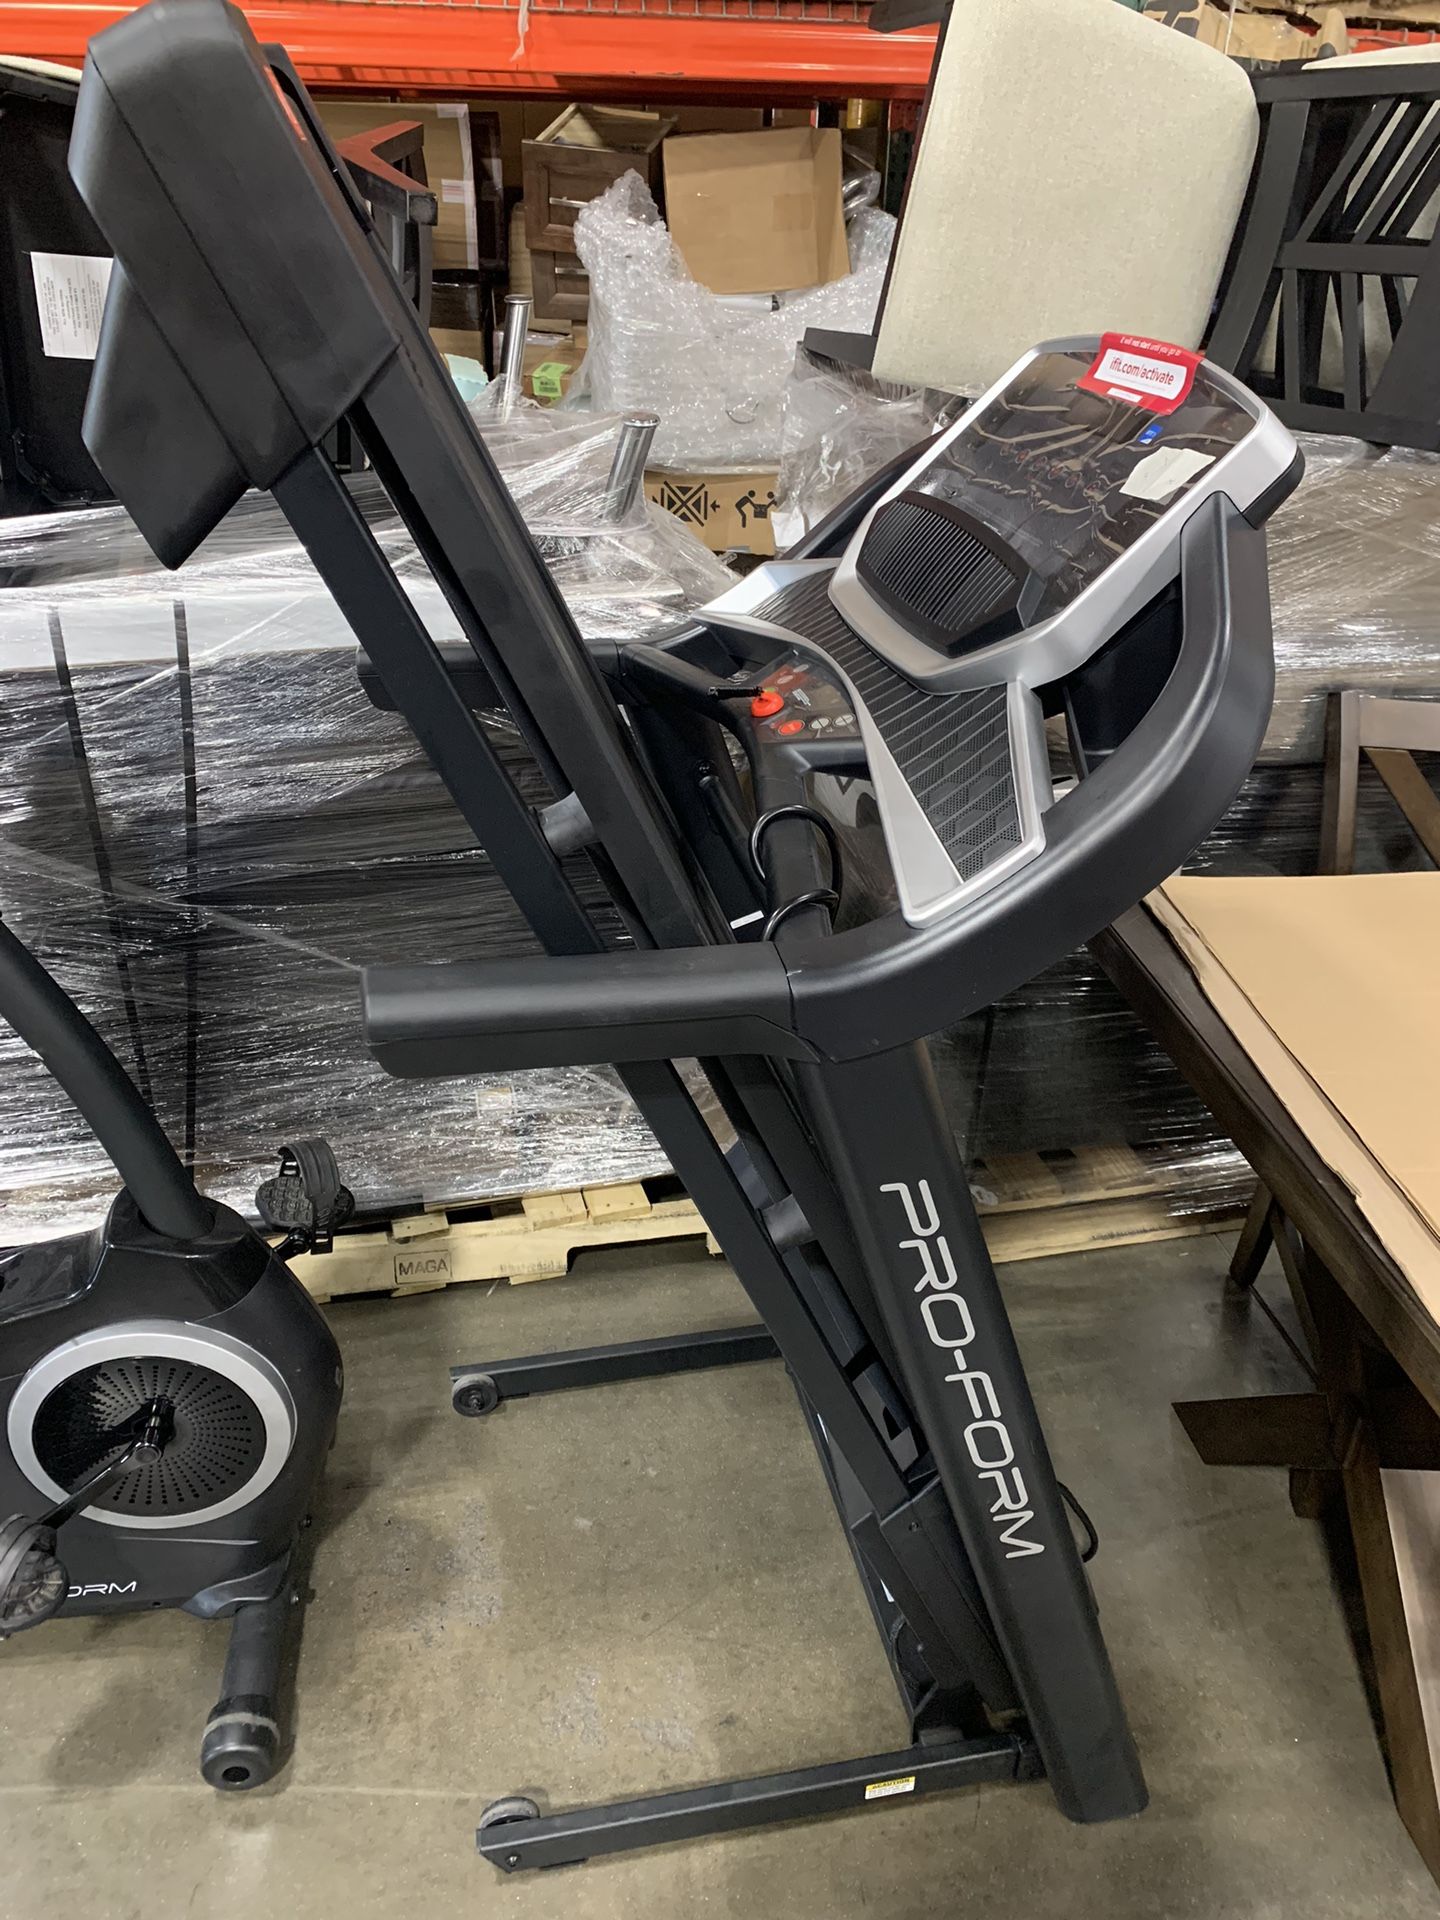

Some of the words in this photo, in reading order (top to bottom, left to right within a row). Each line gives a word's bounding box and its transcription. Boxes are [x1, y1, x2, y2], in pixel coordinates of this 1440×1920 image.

[1109, 356, 1175, 385] ifit.com/activate
[398, 1257, 449, 1276] MAGA
[879, 1178, 1045, 1559] PRO-FORM
